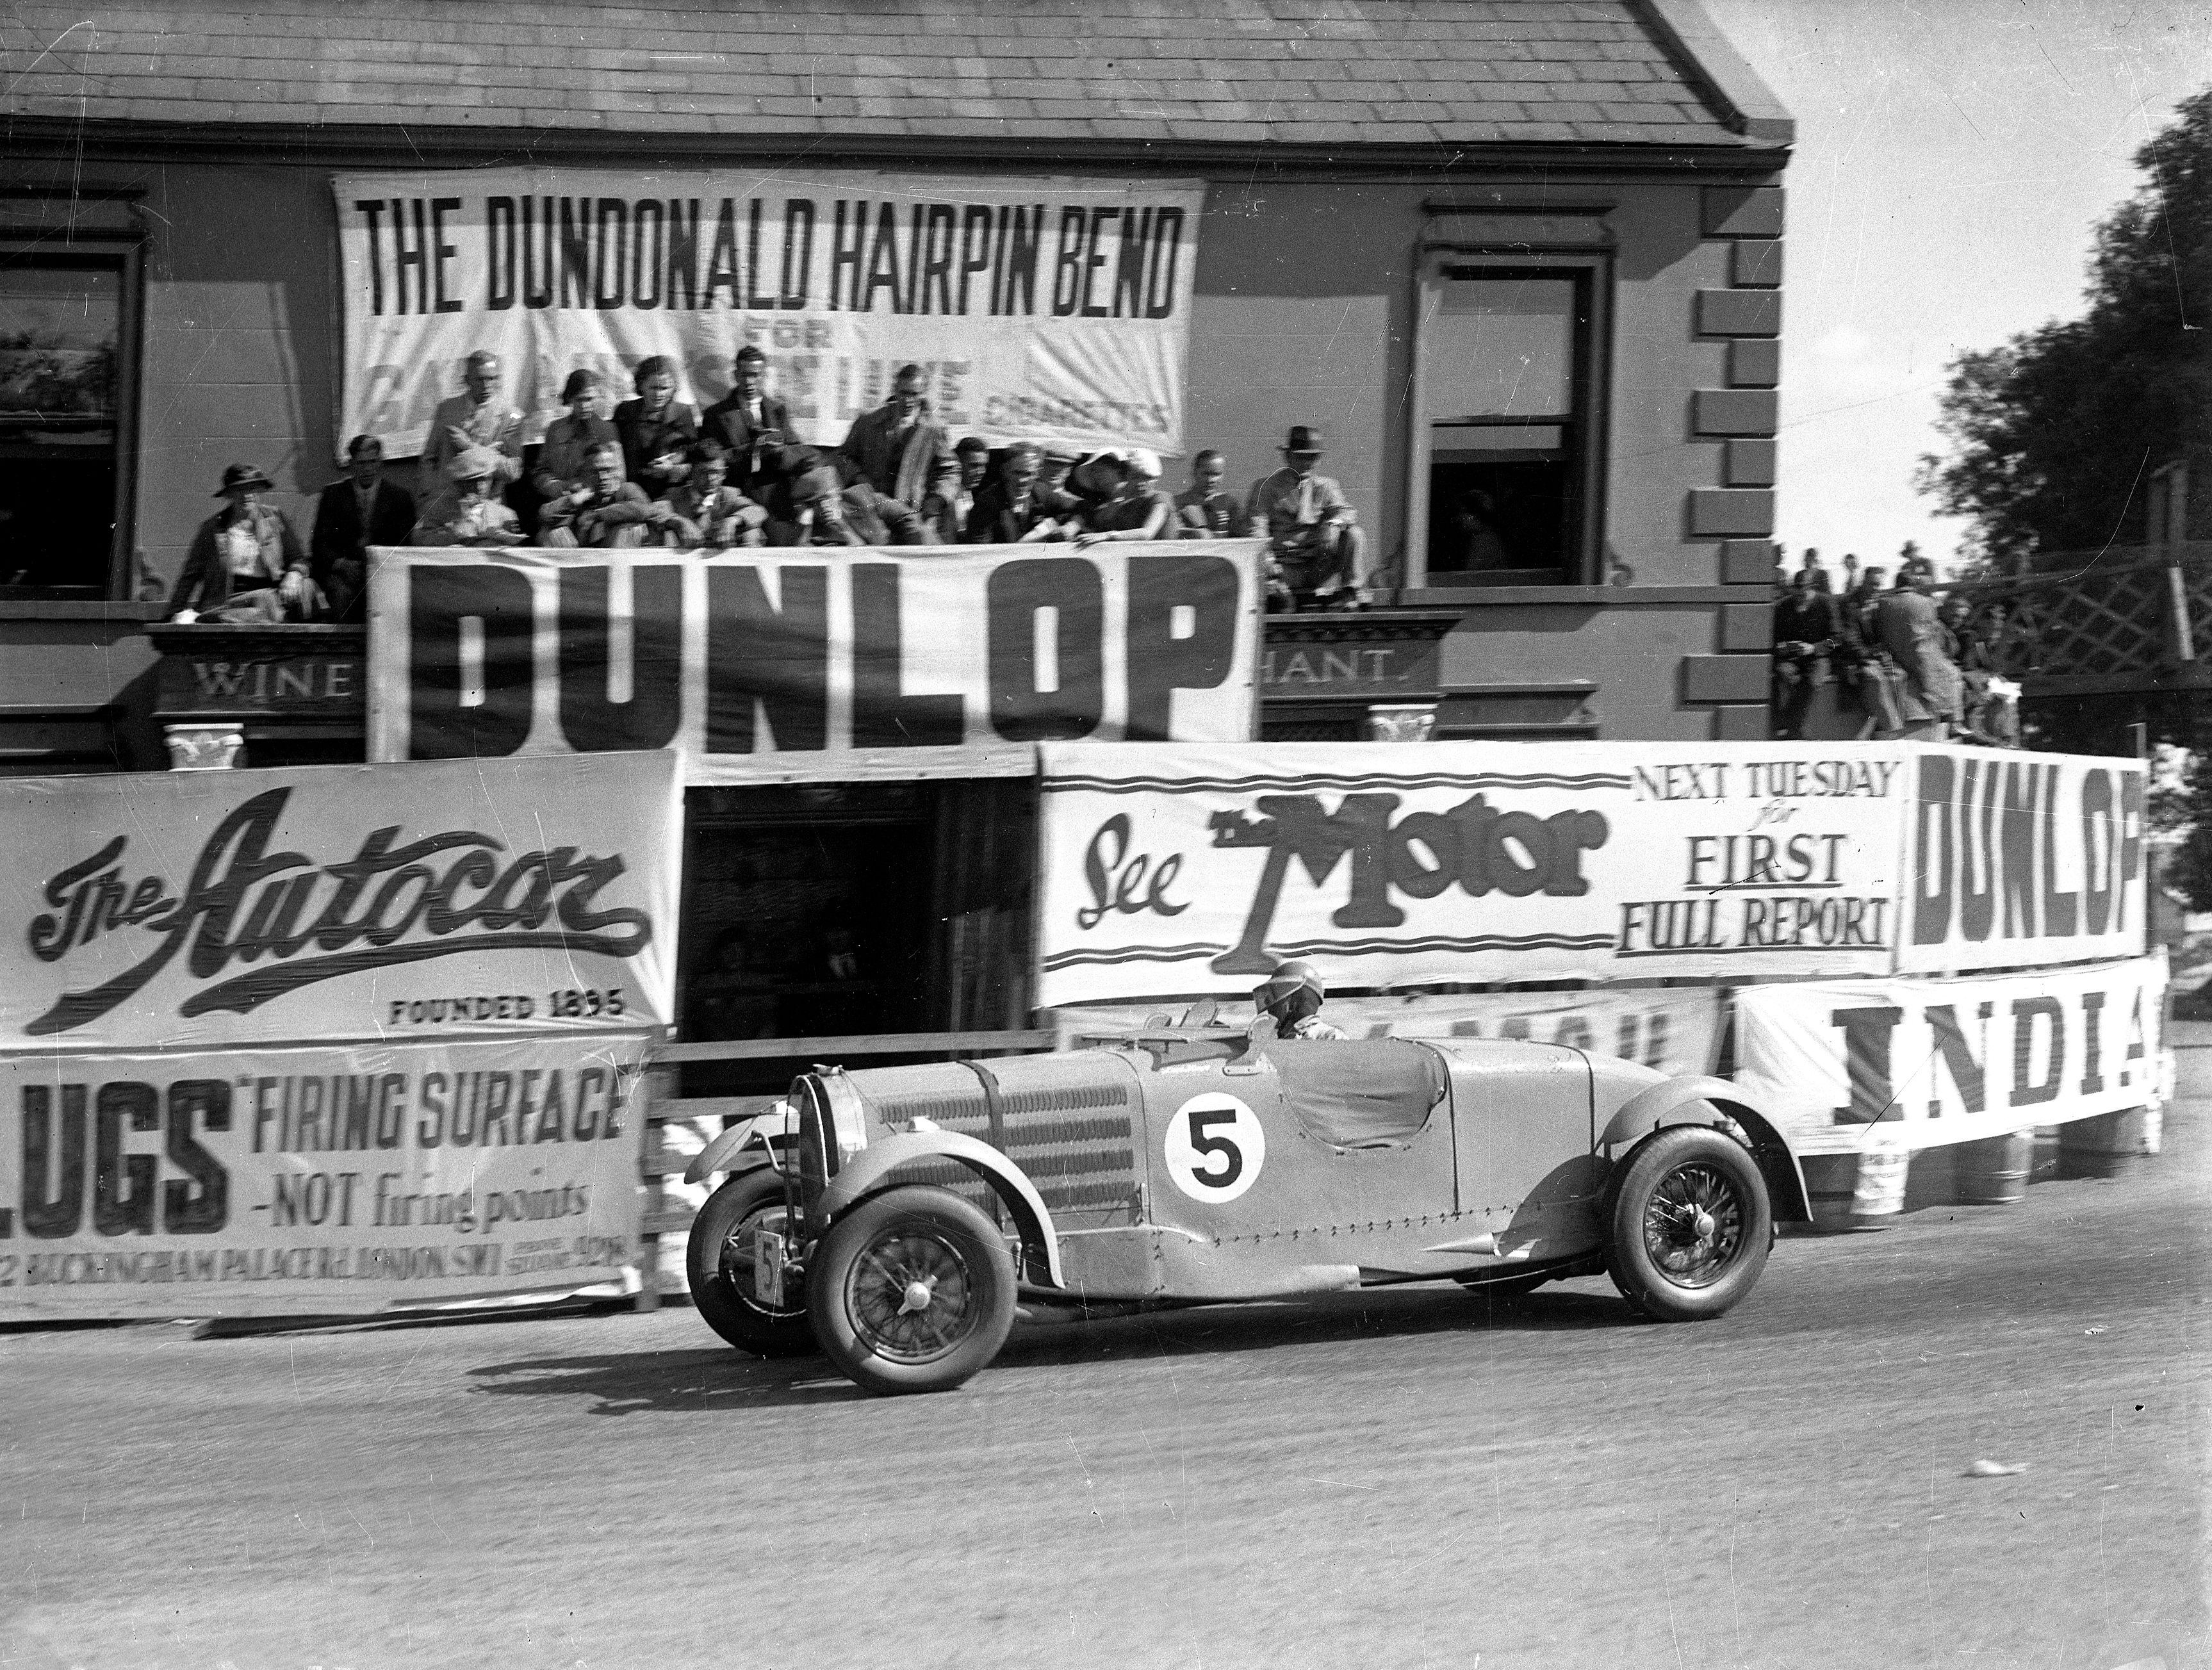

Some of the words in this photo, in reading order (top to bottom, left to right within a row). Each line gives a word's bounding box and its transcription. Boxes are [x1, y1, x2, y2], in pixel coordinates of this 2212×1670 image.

[354, 197, 464, 316] THE
[487, 195, 816, 311] DUNDONALD
[828, 200, 1045, 316] HAIRPIN
[1051, 205, 1184, 319] BEND
[195, 662, 353, 698] WINE
[409, 555, 1240, 761] DUNLOP
[1634, 762, 1731, 801] NEXT
[1743, 760, 1905, 799] TUESDAY
[28, 835, 179, 962] The
[1076, 812, 1192, 931] See
[1209, 792, 1610, 975] Motor
[1683, 833, 1849, 885] FIRST
[24, 786, 652, 1036] Autocar
[1616, 899, 1728, 951] FULL
[1737, 896, 1890, 947] REPORT
[389, 995, 536, 1024] FOUNDED
[249, 1072, 407, 1154] FIRING
[419, 1066, 626, 1149] SURFACE
[1188, 1109, 1243, 1188] 5
[0, 1079, 233, 1239] UGS
[372, 1171, 478, 1233] firing
